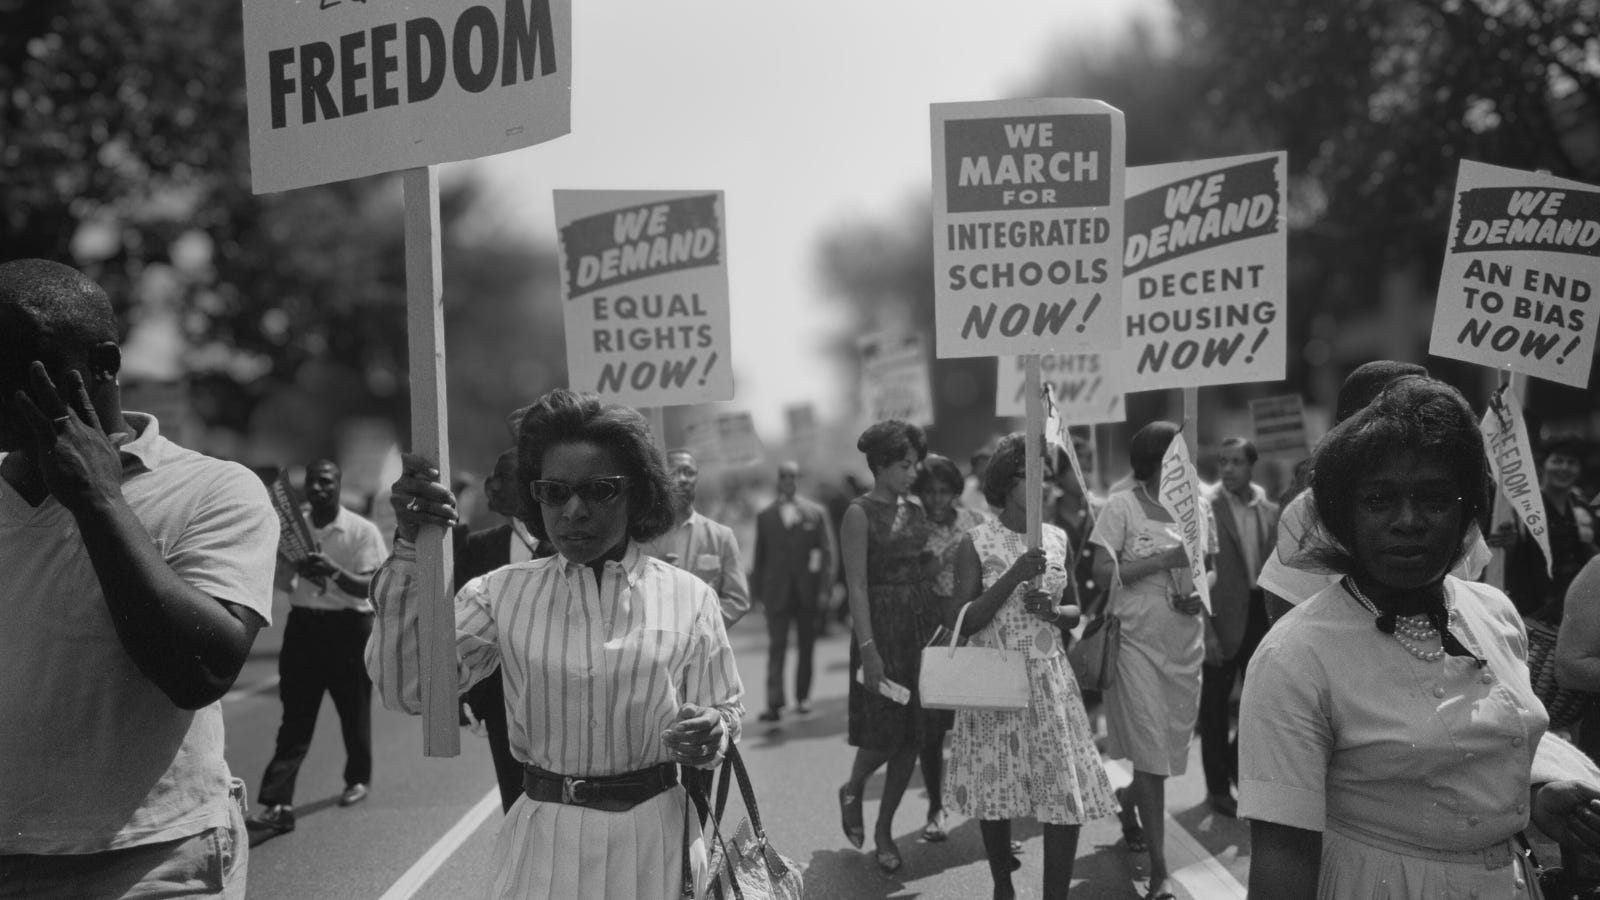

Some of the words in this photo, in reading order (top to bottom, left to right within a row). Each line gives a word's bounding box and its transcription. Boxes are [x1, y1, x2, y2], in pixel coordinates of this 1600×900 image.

[268, 0, 558, 130] FREEDOM
[1004, 122, 1054, 149] WE
[957, 151, 1099, 187] MARCH
[1002, 188, 1058, 206] FOR
[1163, 173, 1226, 219] WE
[1507, 189, 1566, 217] WE
[613, 204, 671, 245] WE
[946, 217, 1111, 251] INTEGRATED
[1123, 194, 1275, 268] DEMAND
[1463, 217, 1600, 248] DEMAND
[575, 227, 716, 289] DEMAND
[948, 258, 1109, 291] SCHOOLS
[1138, 264, 1265, 300] DECENT
[1463, 258, 1513, 288] AN
[1523, 268, 1592, 303] END
[592, 292, 708, 321] EQUAL
[960, 293, 1102, 340] NOW!
[1126, 300, 1277, 337] HOUSING
[1463, 286, 1504, 314] TO
[1512, 296, 1585, 332] BIAS
[592, 323, 713, 353] RIGHTS
[1136, 327, 1270, 375] NOW!
[1456, 317, 1582, 366] NOW!
[596, 351, 718, 395] NOW!
[1161, 453, 1198, 546] FREEDOM
